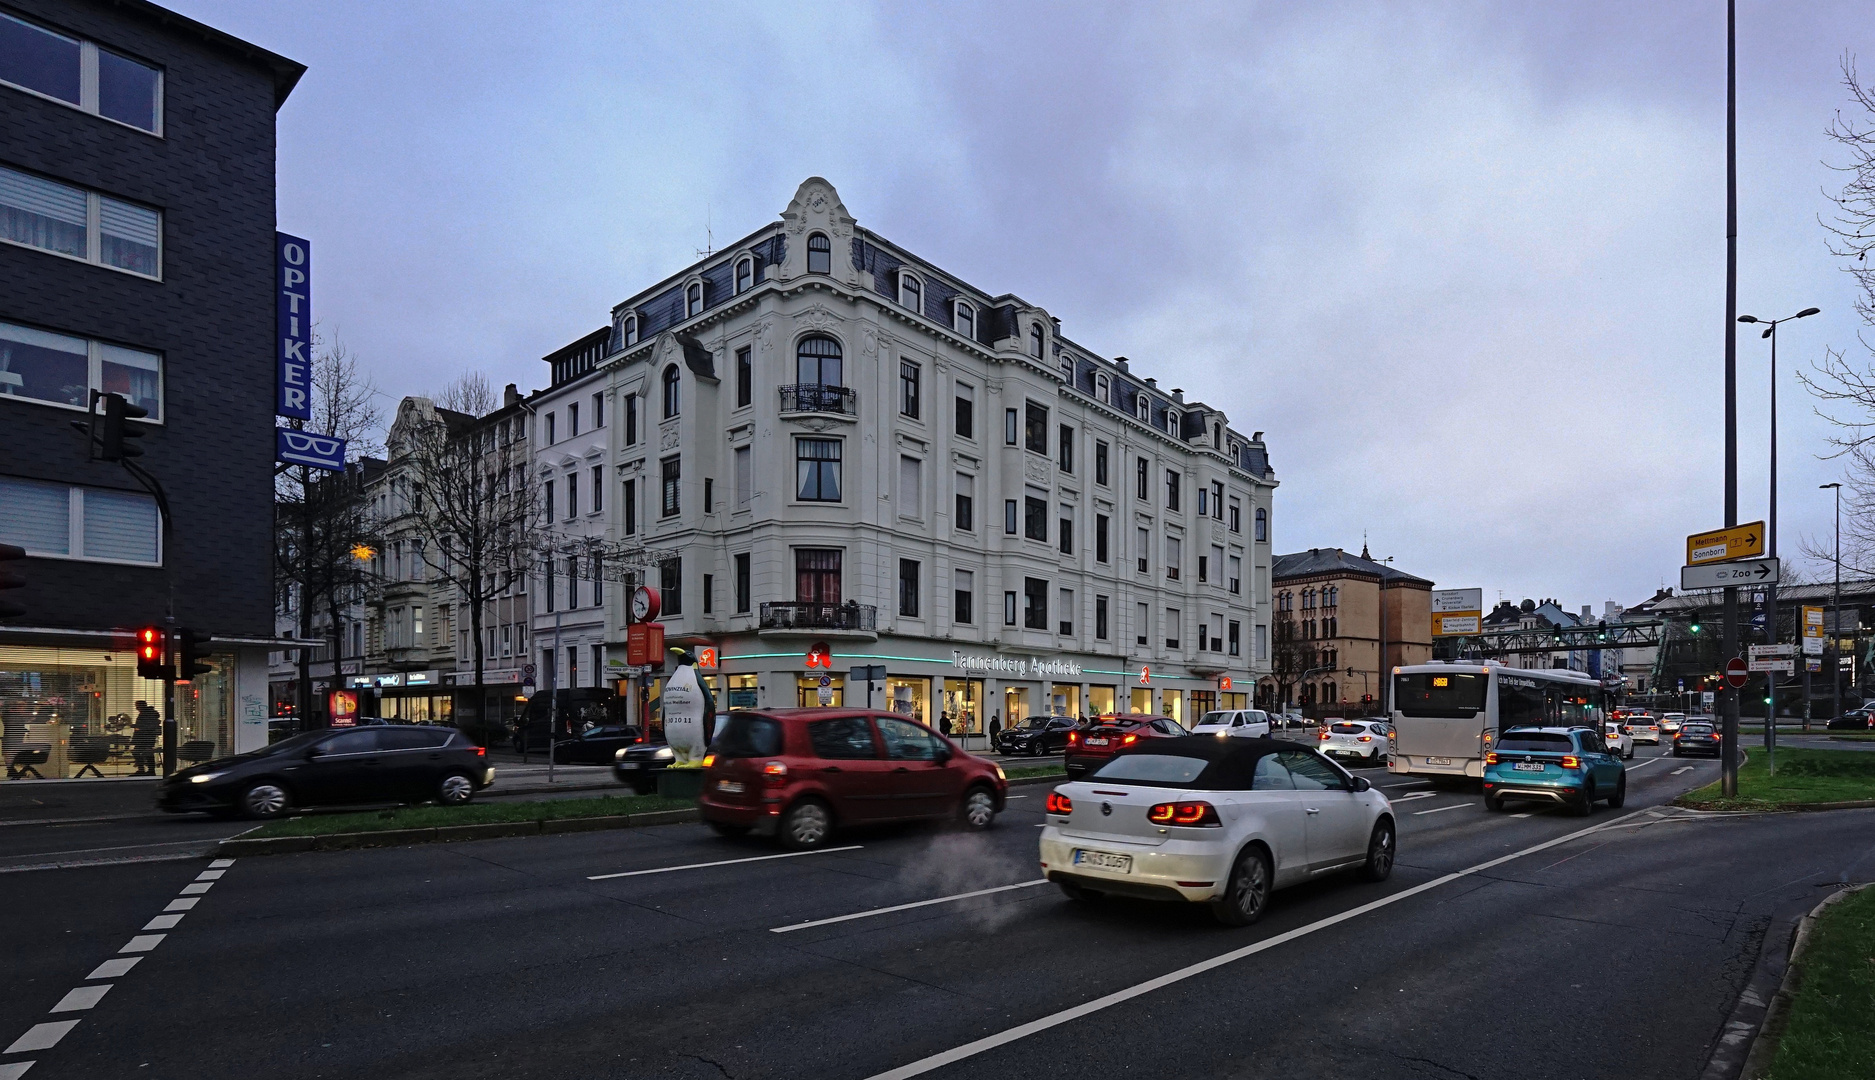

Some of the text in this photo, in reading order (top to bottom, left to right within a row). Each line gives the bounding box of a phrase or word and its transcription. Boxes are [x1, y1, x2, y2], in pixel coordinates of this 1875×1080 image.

[283, 243, 306, 410] OPTIKER
[1695, 535, 1728, 547] Mettmann
[1693, 548, 1725, 559] Sonnborn
[1732, 570, 1751, 578] Zoo
[952, 650, 1082, 677] Tannenberg Apotheke
